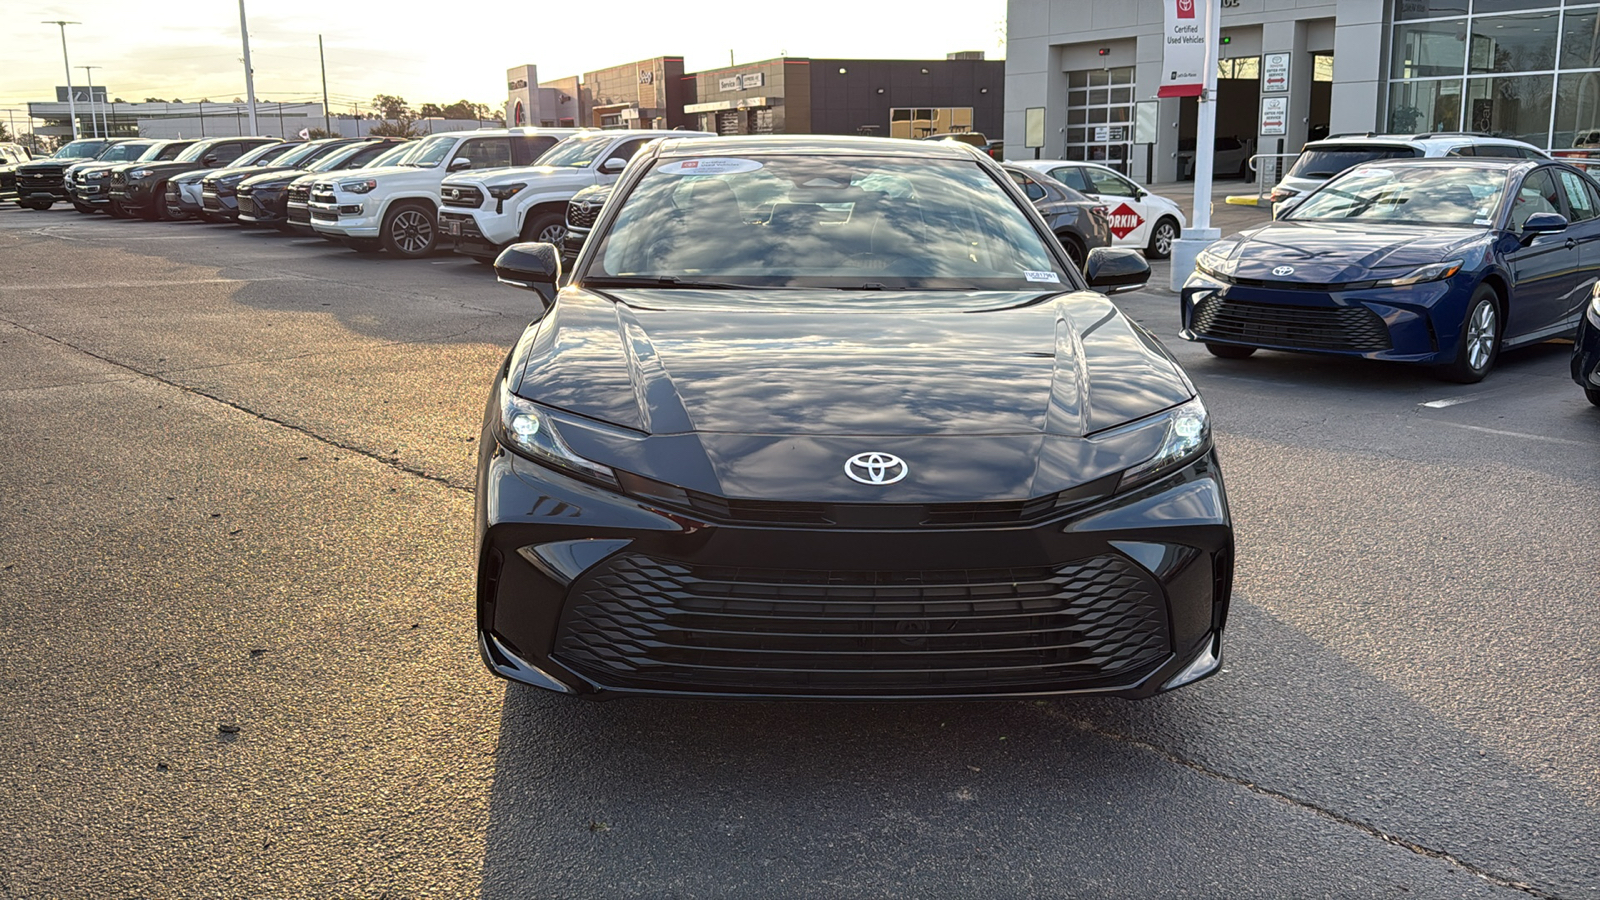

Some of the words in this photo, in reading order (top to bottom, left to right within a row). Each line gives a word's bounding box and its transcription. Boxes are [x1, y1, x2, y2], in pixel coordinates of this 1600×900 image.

[1174, 25, 1198, 33] Certified
[1182, 36, 1204, 44] Vehicles
[721, 80, 735, 89] Service
[1108, 214, 1138, 228] ORKIN
